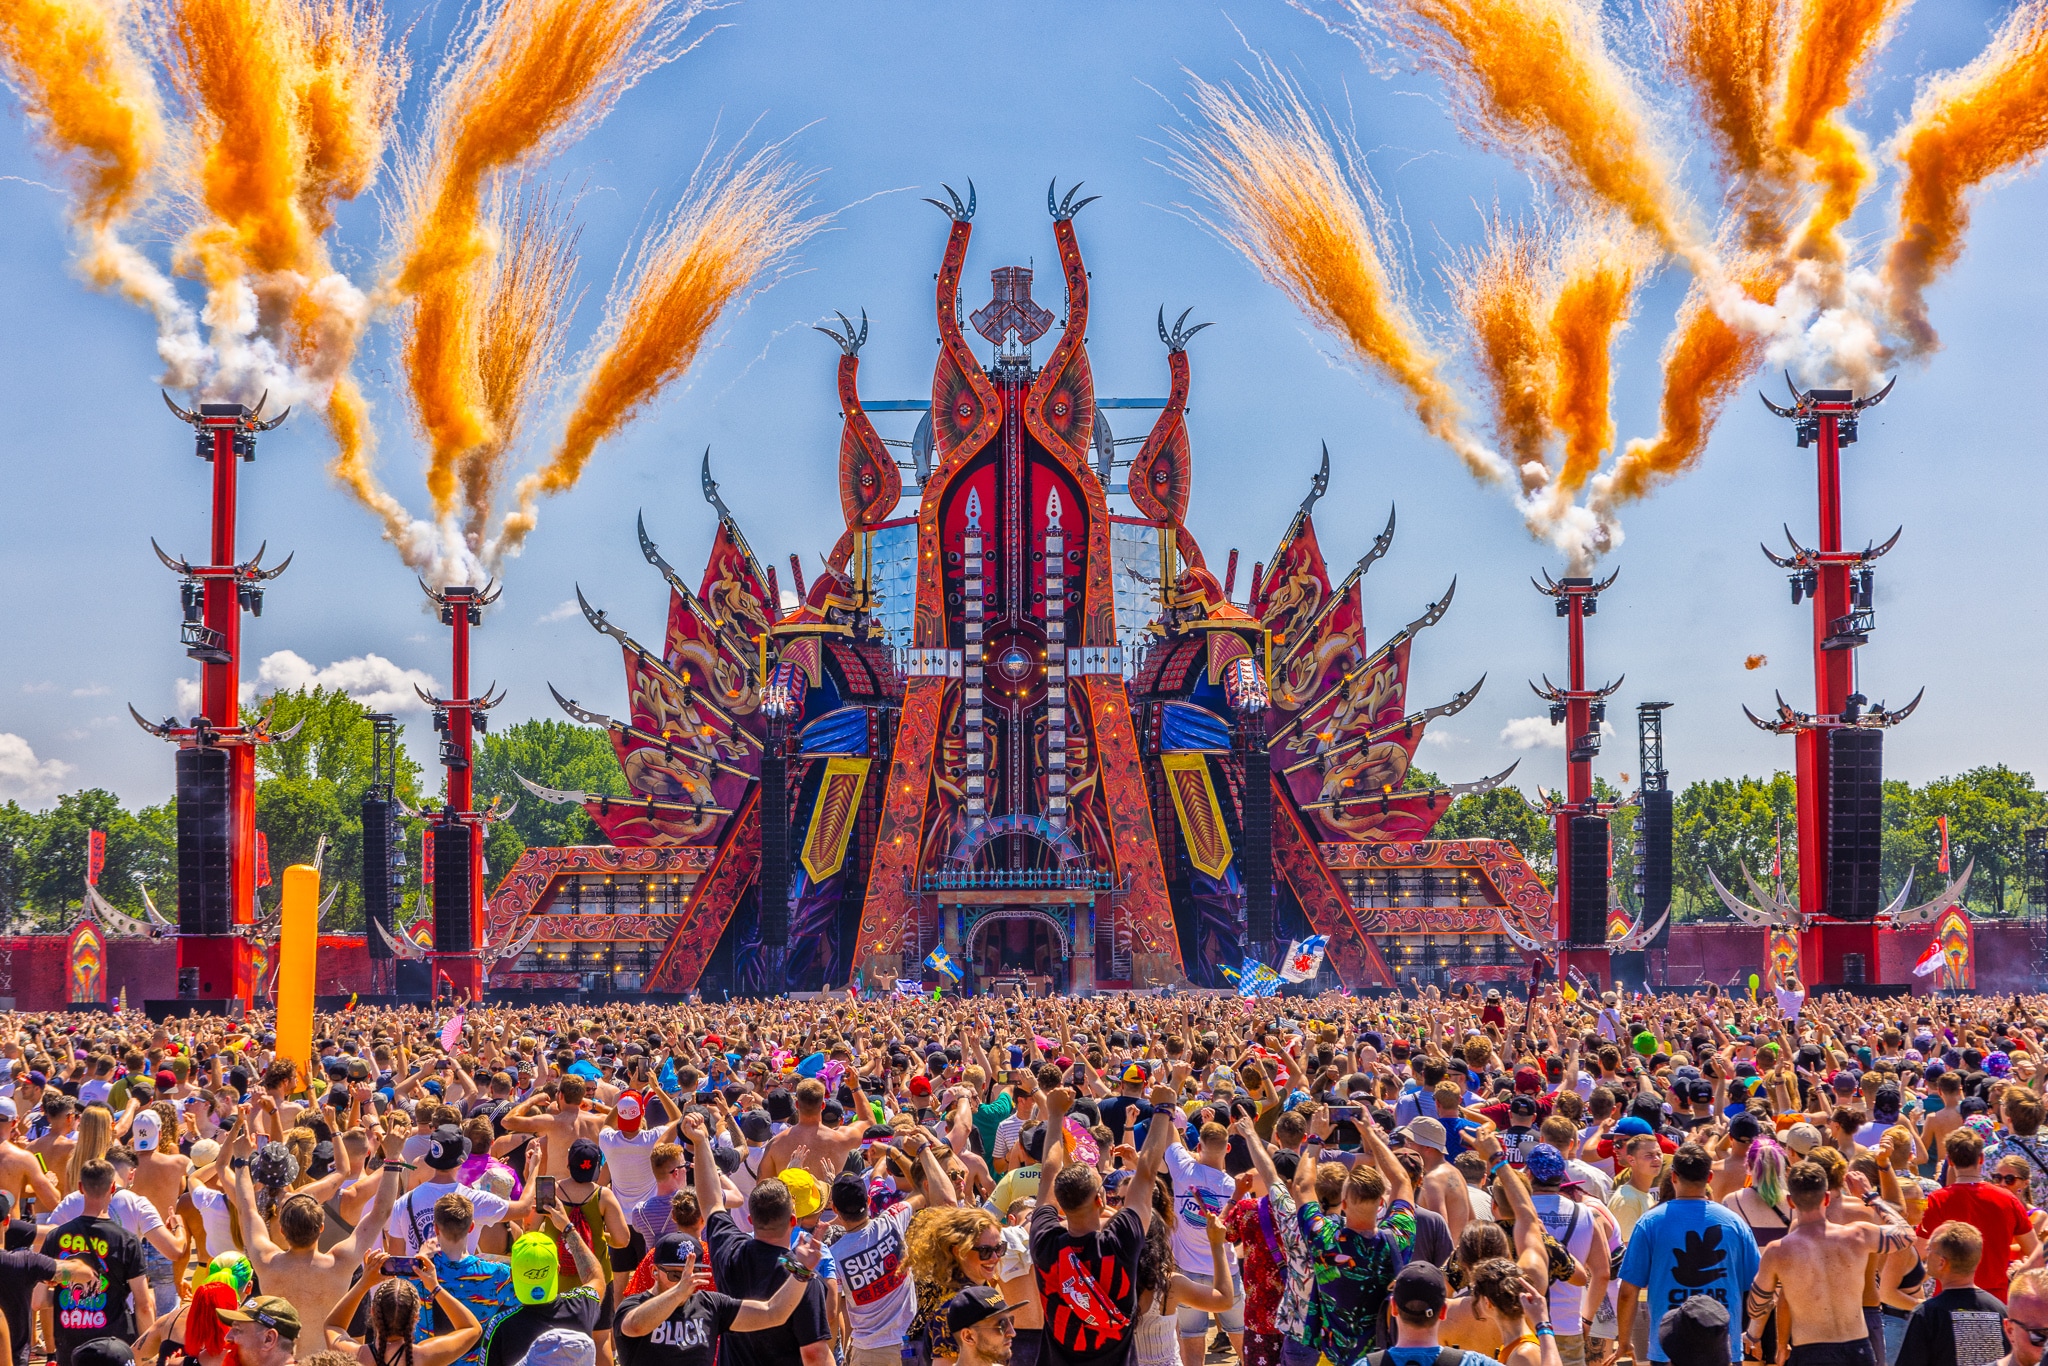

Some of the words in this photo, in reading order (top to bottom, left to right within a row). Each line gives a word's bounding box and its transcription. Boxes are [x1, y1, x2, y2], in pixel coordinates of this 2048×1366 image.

[844, 1235, 899, 1276] SUPER
[523, 1265, 550, 1280] 46
[850, 1264, 886, 1290] DRY
[60, 1311, 107, 1327] GANG
[652, 1318, 708, 1346] BLACK
